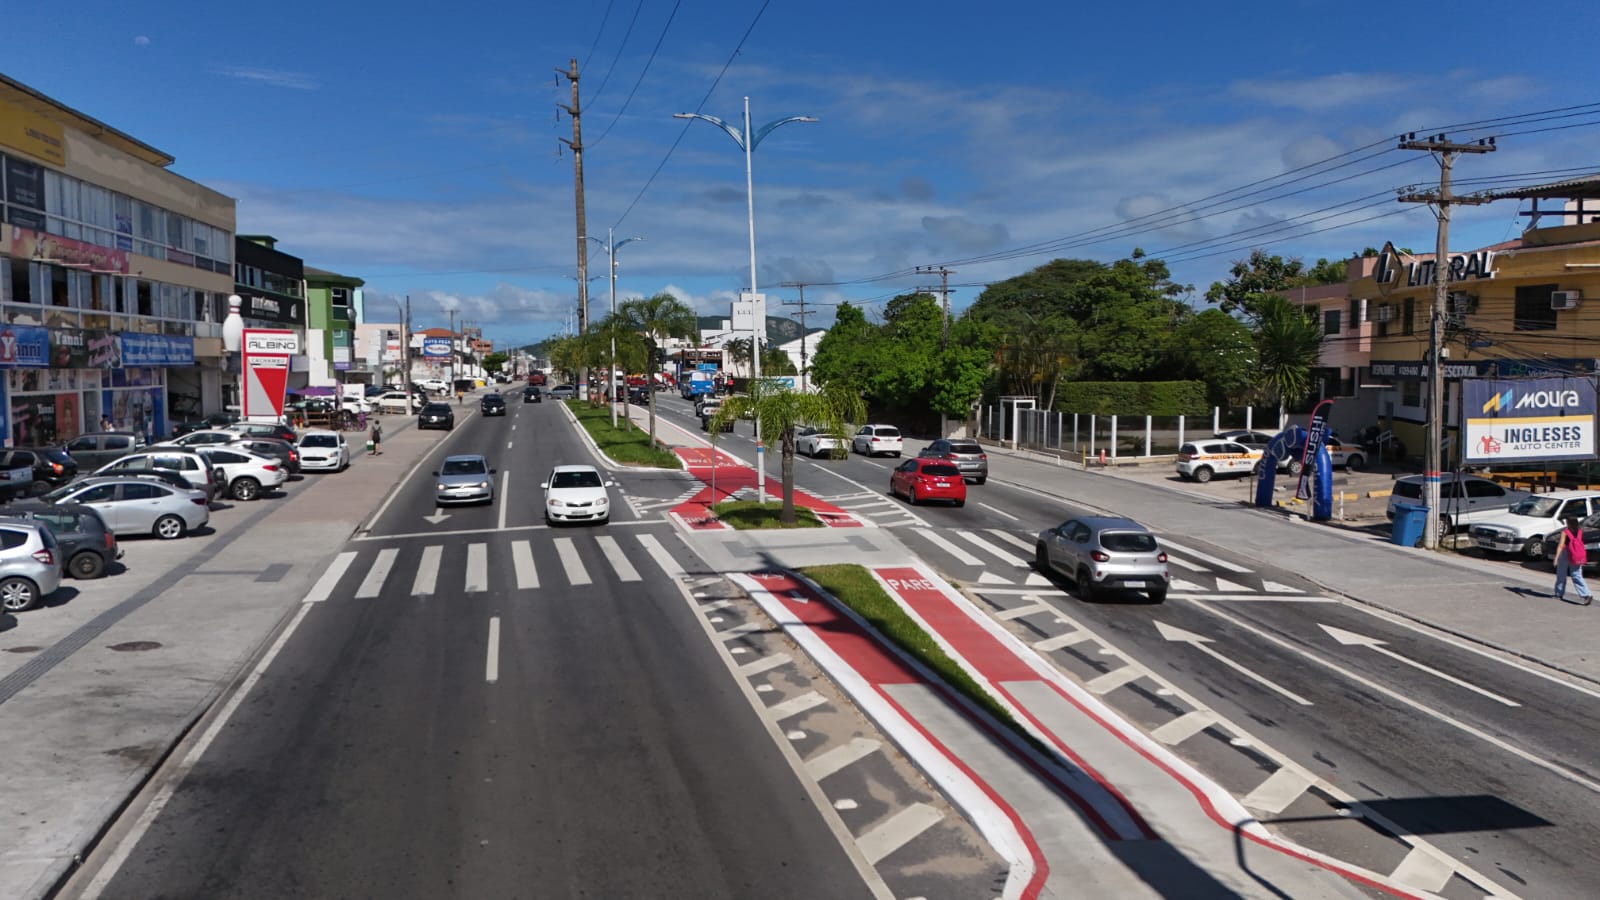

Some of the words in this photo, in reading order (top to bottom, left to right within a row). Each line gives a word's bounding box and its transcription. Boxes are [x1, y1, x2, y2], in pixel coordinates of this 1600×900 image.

[1407, 250, 1498, 287] LITRAL
[54, 331, 84, 346] Yanni
[248, 341, 296, 350] ALBINO
[1, 336, 41, 358] Yanni
[1305, 415, 1323, 465] SUSHI
[1504, 426, 1581, 444] INGLESES
[1513, 442, 1541, 450] AUTO
[1545, 441, 1580, 449] CENTER
[886, 579, 937, 590] PARE
